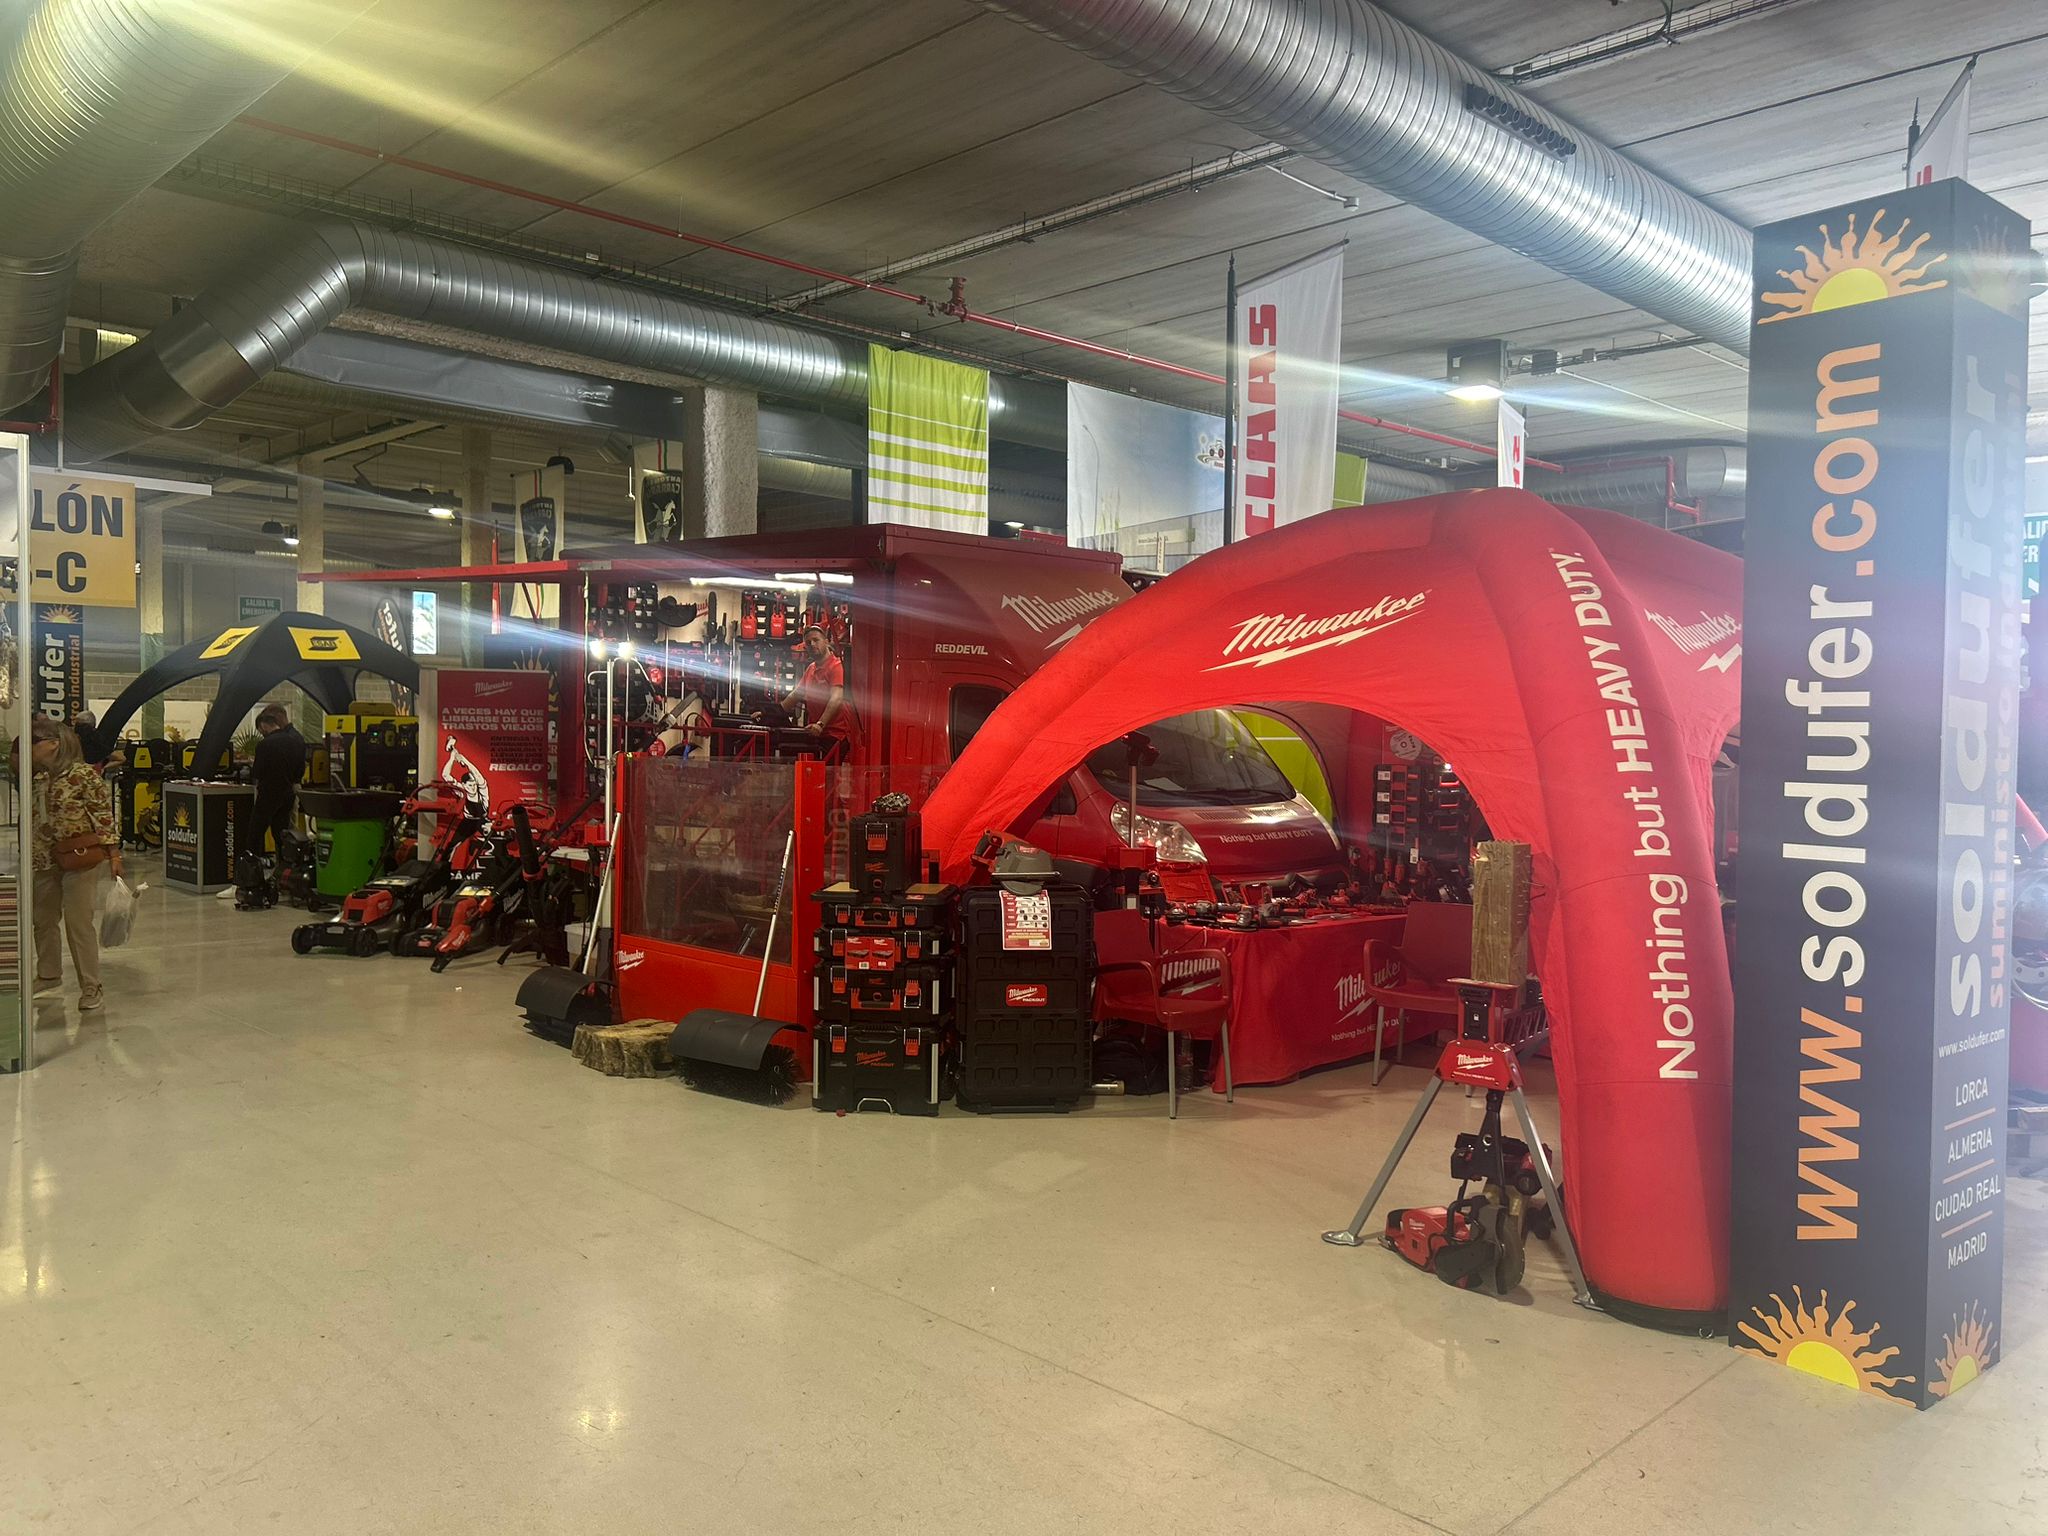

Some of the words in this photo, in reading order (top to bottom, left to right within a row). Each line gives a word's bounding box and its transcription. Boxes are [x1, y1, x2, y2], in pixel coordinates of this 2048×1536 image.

[1245, 304, 1277, 537] CLAAS
[31, 483, 124, 538] LÓN
[1000, 588, 1120, 633] Milwaukee
[1222, 592, 1426, 657] Milwaukee
[1643, 610, 1742, 656] Milwaukee
[39, 633, 67, 723] dufer
[68, 633, 81, 698] industrial
[1945, 354, 1996, 1019] soldufer
[442, 715, 500, 723] LIBRARSE
[521, 716, 544, 724] LOS
[442, 723, 498, 731] TRASTOS
[501, 723, 544, 731] VIEJOS
[1583, 635, 1653, 773] HEAVY
[1782, 342, 1882, 1240] www.soldufer.com
[168, 828, 198, 844] soldufer
[1623, 786, 1672, 857] but
[1645, 873, 1699, 1080] Nothing
[1938, 1027, 2006, 1059] www.soldufer.com
[1955, 1077, 1989, 1107] LORCA
[1948, 1127, 1993, 1164] ALMERIA
[1935, 1186, 1974, 1222] CIUDAD
[1975, 1174, 2002, 1204] REAL
[1947, 1231, 1988, 1270] MADRID
